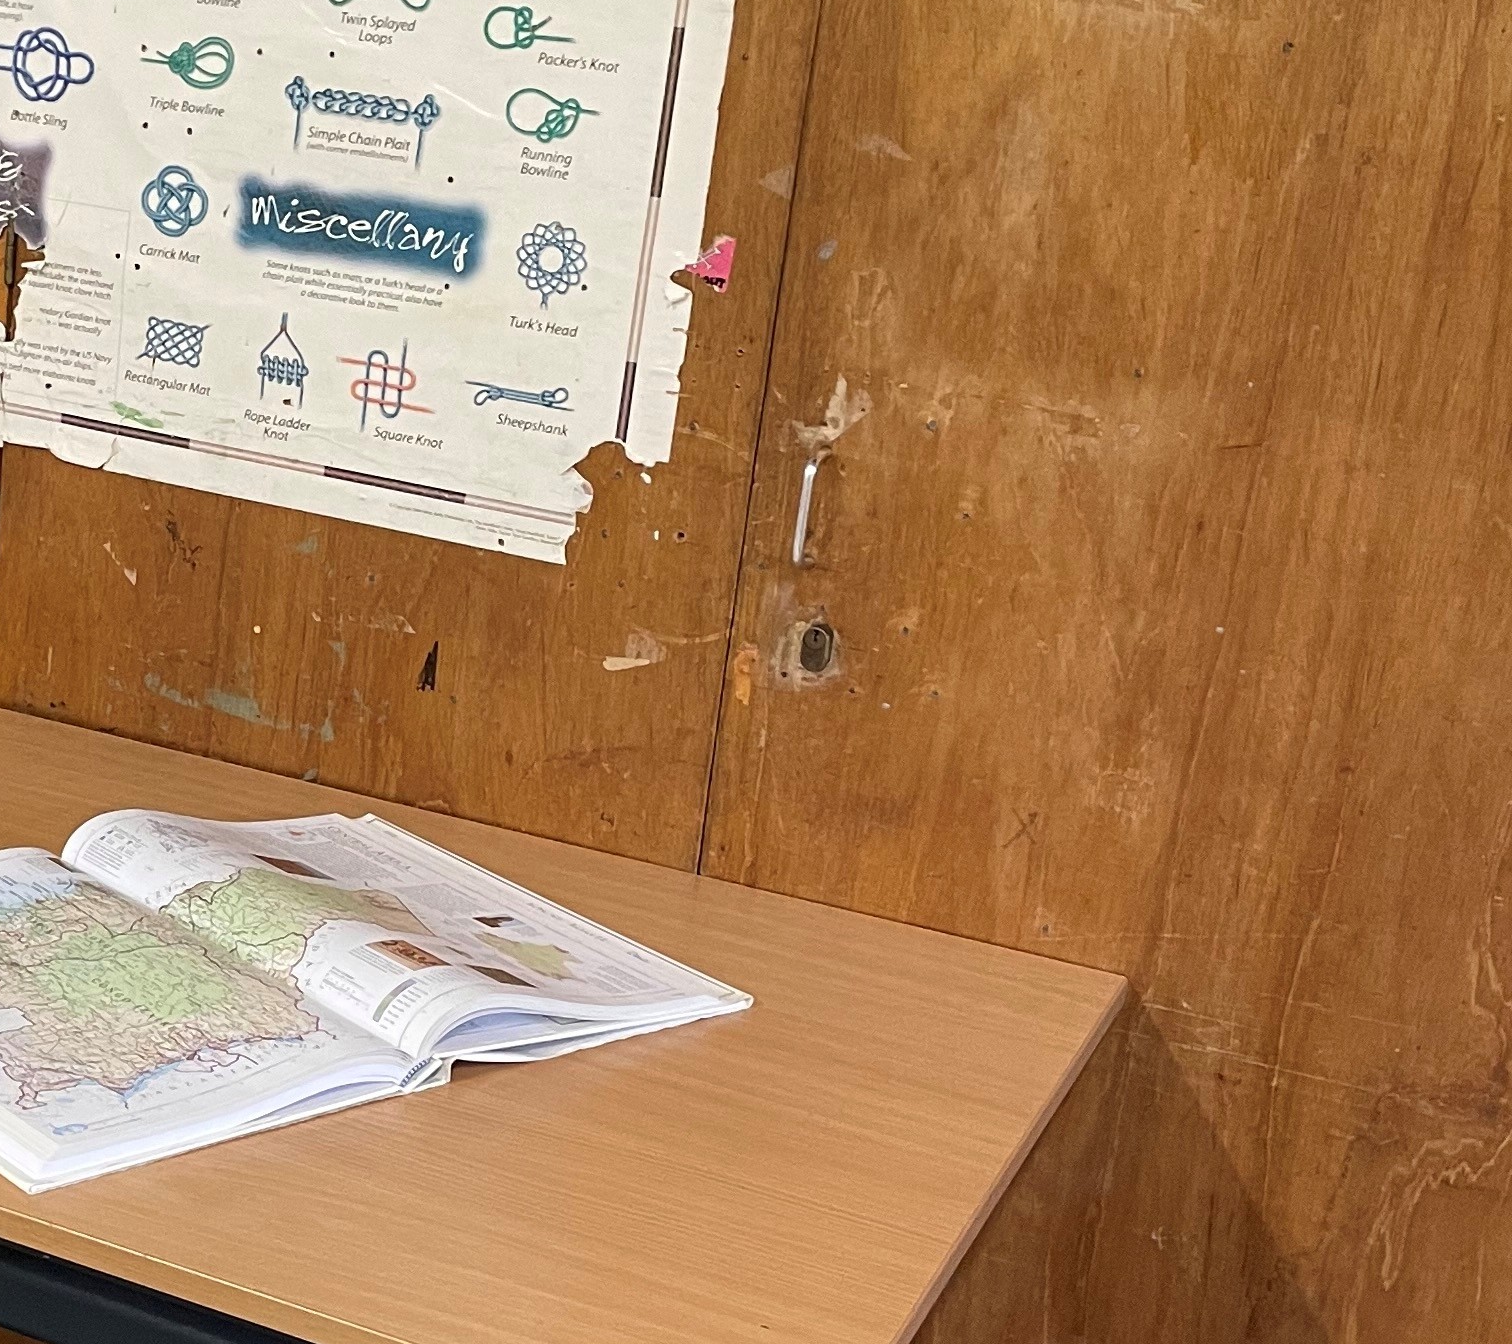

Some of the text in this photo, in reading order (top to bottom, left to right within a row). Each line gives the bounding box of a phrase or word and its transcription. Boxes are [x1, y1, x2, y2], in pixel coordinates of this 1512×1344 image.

[341, 11, 416, 34] Twin Splayed
[358, 30, 393, 46] Loops
[538, 52, 620, 74] Packer's Knot
[150, 96, 225, 117] Triple Bowline
[43, 115, 67, 130] Sling
[307, 126, 345, 143] Simple
[347, 132, 380, 149] Chain
[384, 138, 411, 153] Plait
[521, 147, 573, 166] Running
[520, 163, 569, 181] Bowline
[252, 195, 474, 272] Miscellany
[139, 244, 200, 264] Carrick Mat
[510, 315, 578, 338] Turk's Head
[125, 370, 210, 397] Rectangular Mat
[244, 408, 311, 433] Rope Ladder
[497, 412, 569, 439] Sheepshank
[263, 426, 289, 442] Knot
[374, 426, 443, 450] Square Knot
